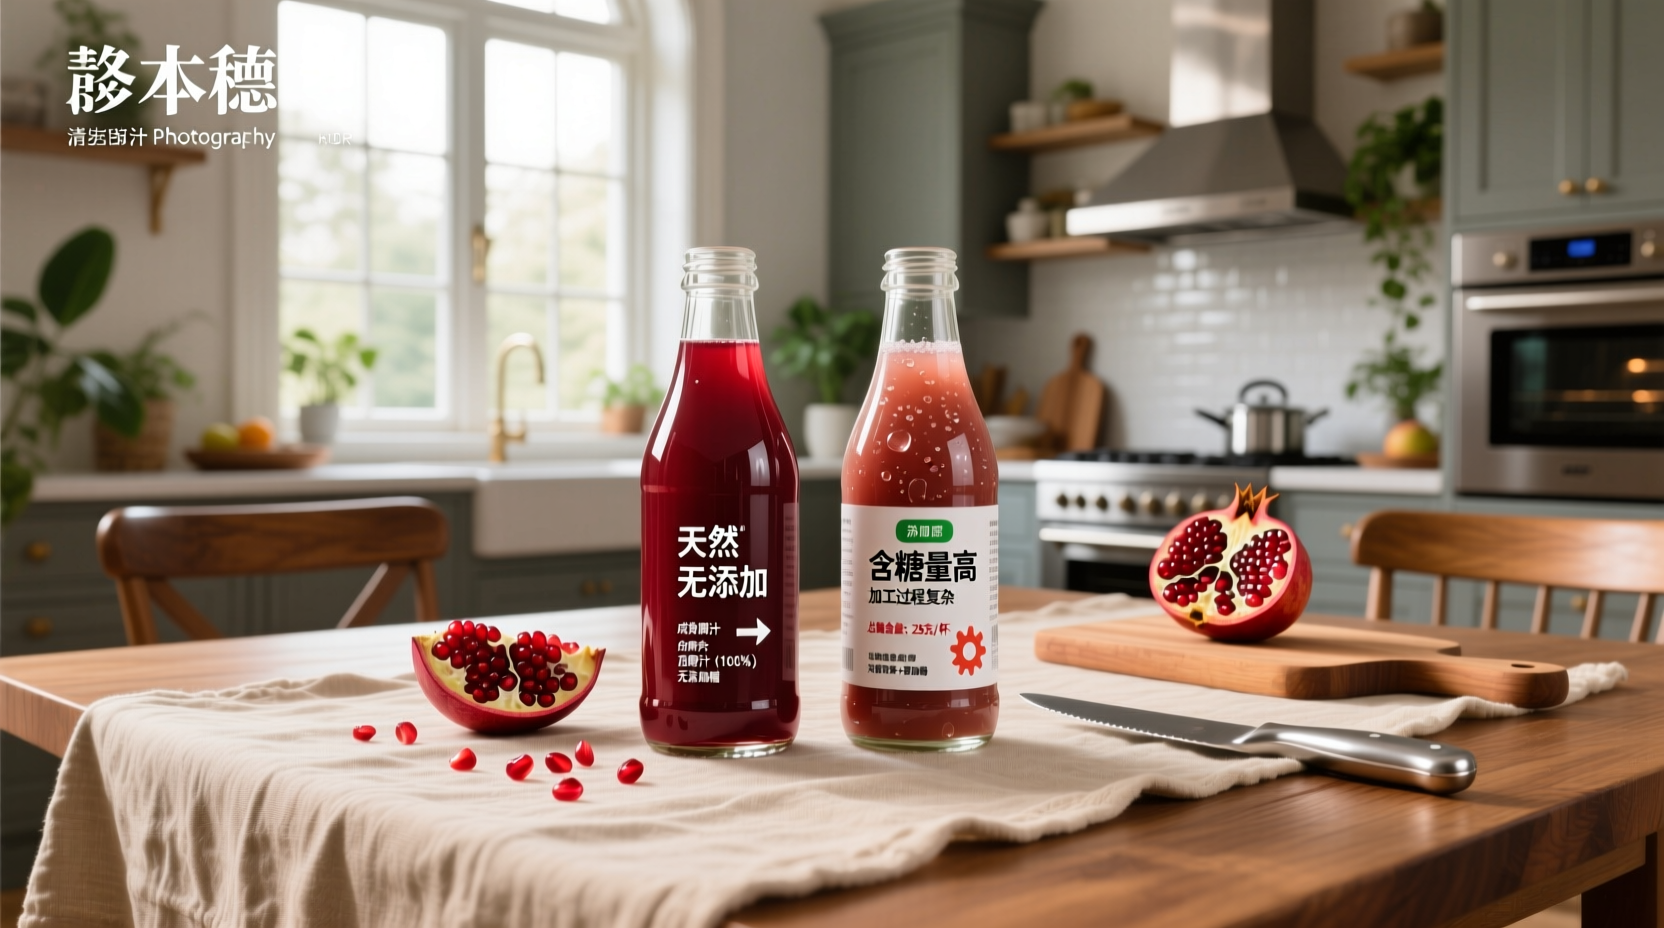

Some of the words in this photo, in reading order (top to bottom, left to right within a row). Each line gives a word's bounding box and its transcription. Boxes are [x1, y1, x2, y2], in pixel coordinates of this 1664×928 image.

[677, 564, 768, 599] 无添加
[868, 549, 978, 583] 含糖量高
[868, 586, 955, 606] 加工过程复杂
